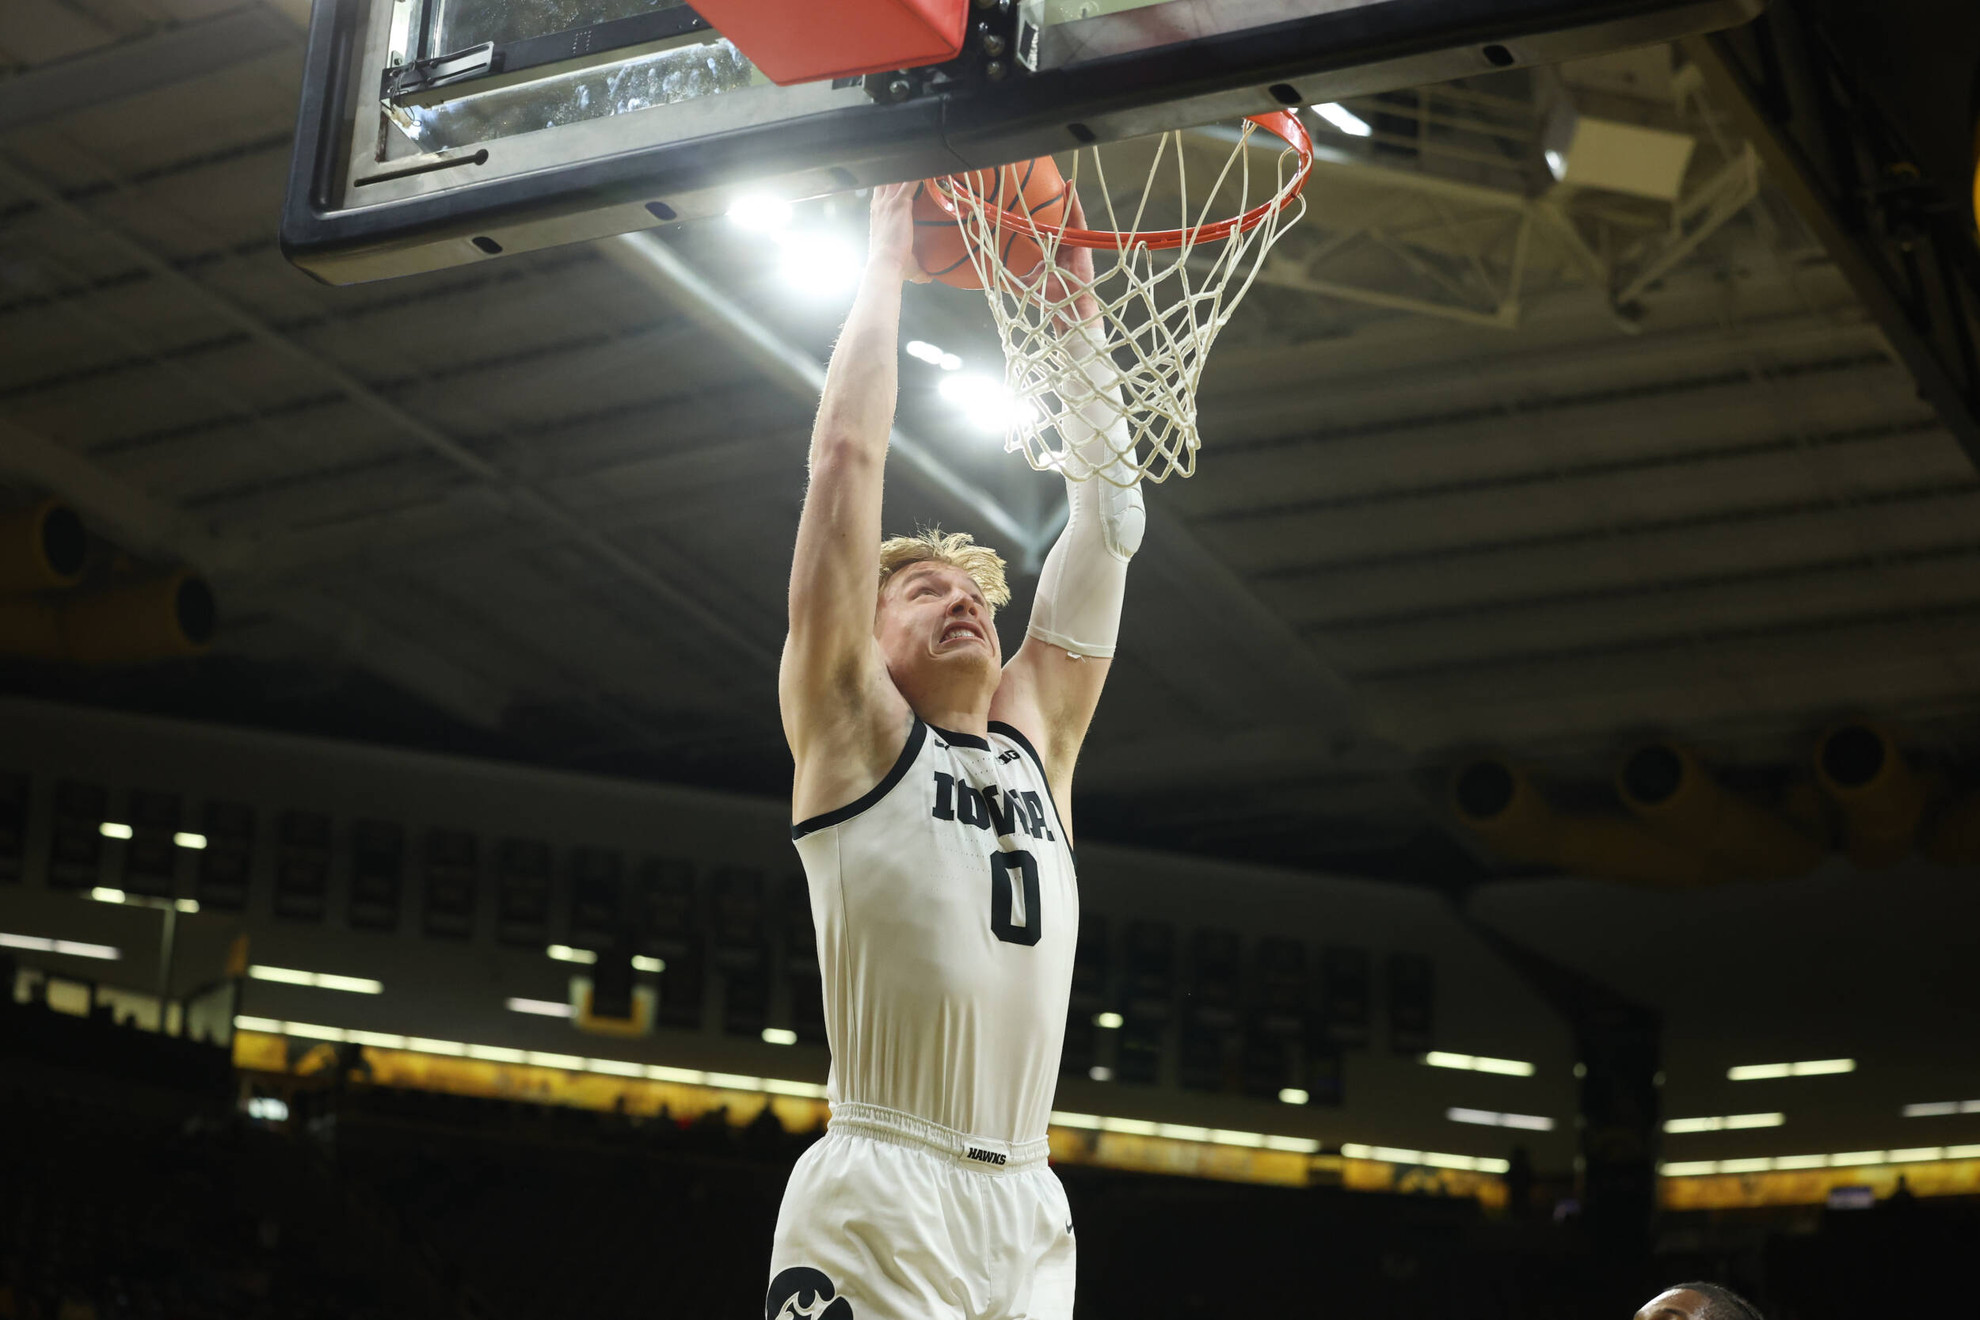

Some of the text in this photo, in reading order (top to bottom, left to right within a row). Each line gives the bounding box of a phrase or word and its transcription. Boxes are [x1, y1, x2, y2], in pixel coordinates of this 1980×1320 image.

[932, 771, 1055, 841] IOWA
[990, 850, 1041, 946] 0
[967, 1147, 1006, 1165] HAWKS
